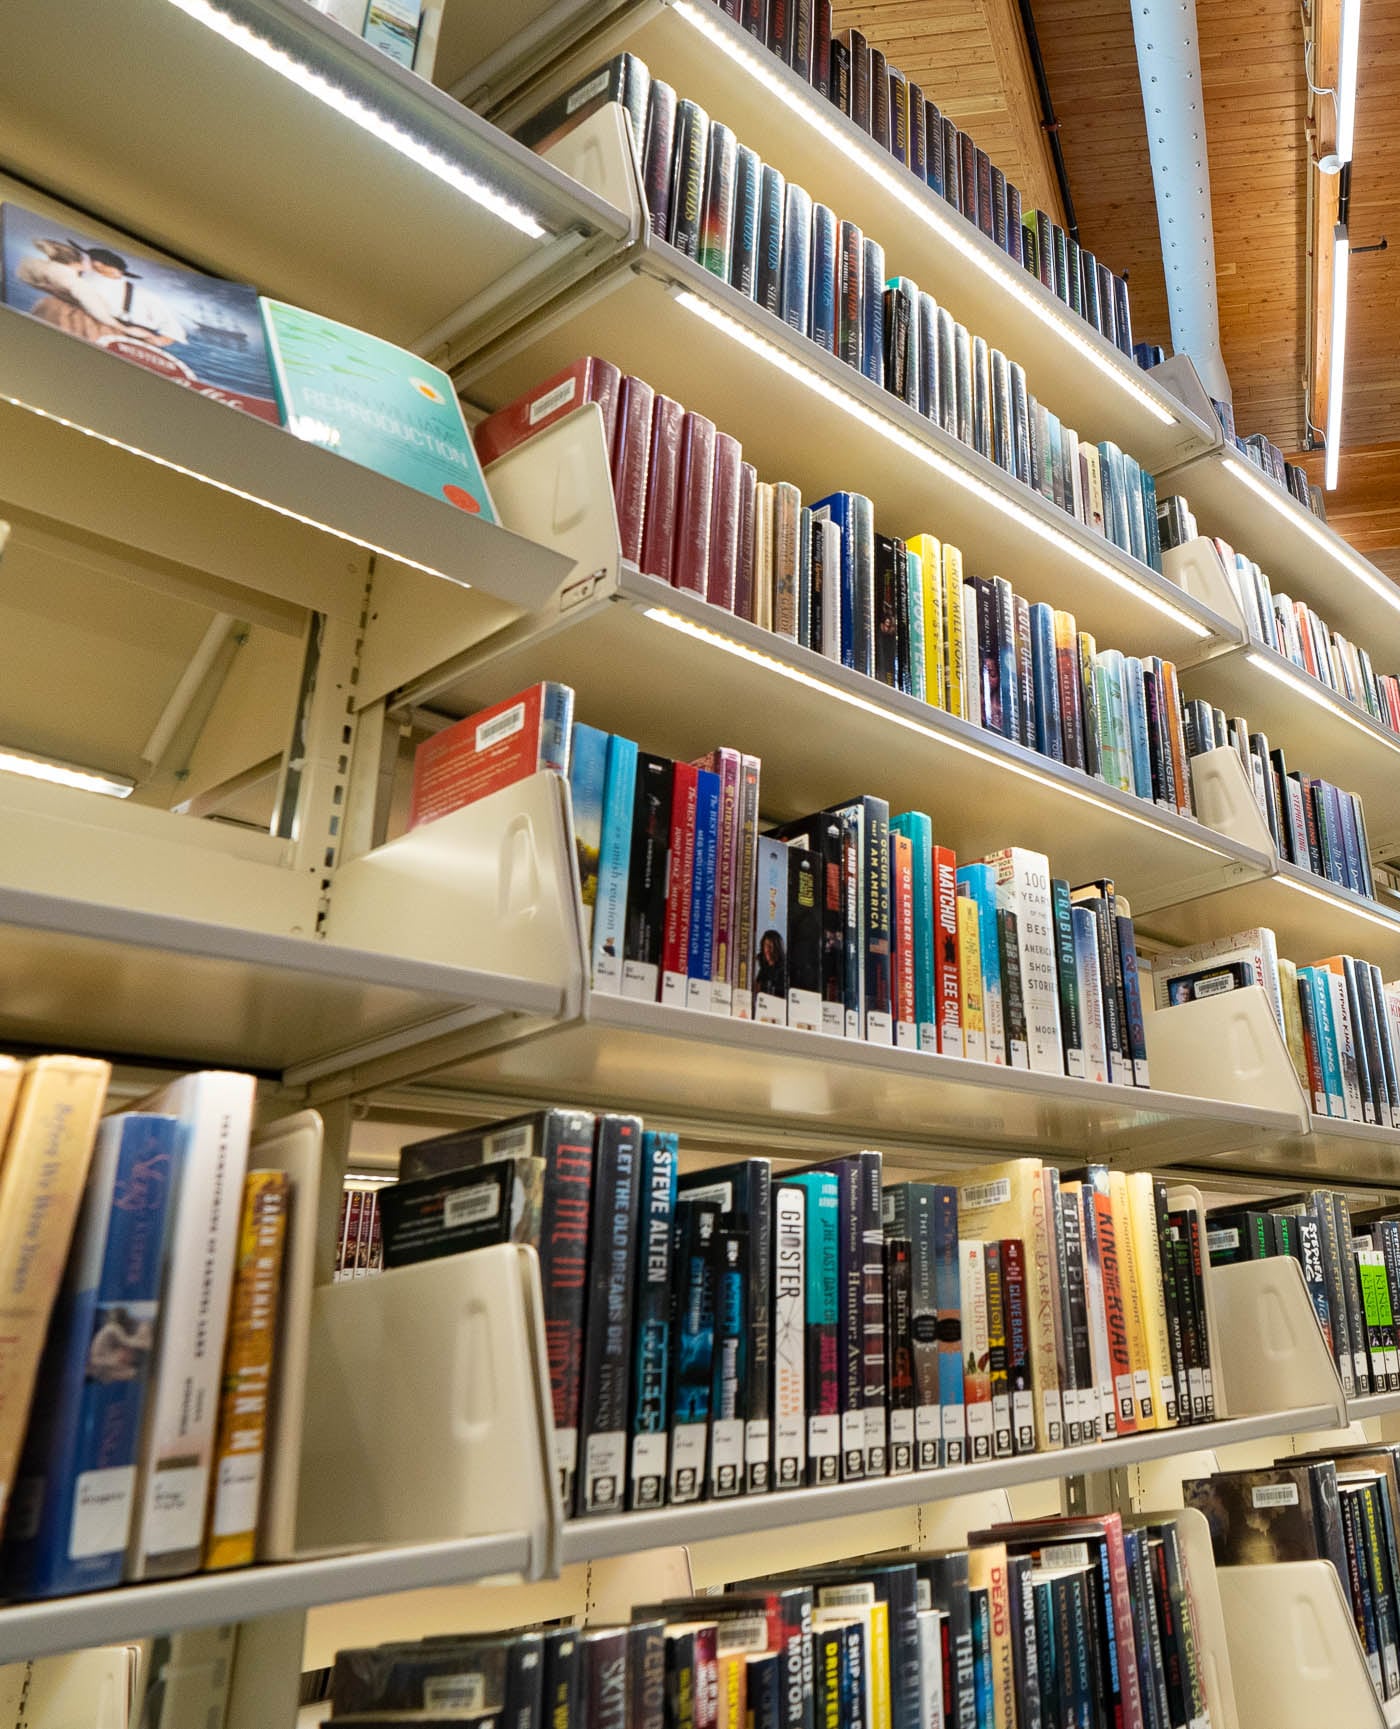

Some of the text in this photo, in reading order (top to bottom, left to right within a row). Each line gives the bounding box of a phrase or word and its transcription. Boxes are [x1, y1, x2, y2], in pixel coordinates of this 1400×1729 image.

[685, 112, 701, 221] STUART WOODS
[743, 203, 755, 251] WOODS
[767, 225, 779, 271] WOODS
[823, 262, 835, 306] WOODS
[848, 232, 858, 320] STUART WOODS
[119, 342, 178, 371] WESTERN
[848, 330, 858, 356] SKIN
[300, 385, 469, 467] REPRODUCTION
[953, 602, 961, 633] MILL
[954, 640, 963, 680] ROAD
[1018, 607, 1033, 704] LOLA ON FIRE
[1063, 675, 1074, 739] HESTER YOUNG
[1163, 742, 1176, 803] VENGEAN
[722, 798, 735, 858] CHRISTMAS
[1293, 794, 1307, 852] STEPHEN KING
[1302, 776, 1316, 846] STEPHEN KING
[606, 842, 624, 930] amish reunion
[678, 787, 696, 973] The BEST AMERICAN SHORT STORIES
[702, 795, 718, 976] The BEST AMERICAN SHORT STORIES
[739, 834, 753, 956] CHRISTMAS HEART
[847, 876, 857, 928] SENTENCES
[869, 848, 880, 929] AM AMERICA
[880, 823, 889, 930] IT OCCURS TO ME
[903, 867, 911, 890] JOE
[938, 864, 956, 934] MATCHUP
[1024, 871, 1047, 890] 100
[669, 886, 679, 943] HEIDI PITLOR
[691, 899, 701, 954] HEIDI PITLOR
[720, 894, 731, 931] HEART
[1057, 887, 1074, 964] PROBING
[942, 974, 958, 997] LEE
[1114, 953, 1122, 987] OUTTA
[1108, 999, 1119, 1049] SHADOWED
[1316, 977, 1337, 1073] STEPHEN KING
[1337, 982, 1351, 1053] STEPHEN KING
[555, 1145, 592, 1188] LET
[848, 1168, 860, 1212] Nicholas
[551, 1200, 590, 1243] ME
[606, 1144, 633, 1354] LET THE OLD DREAMS DIE
[648, 1151, 672, 1282] STEVE ALTEN
[1088, 1197, 1097, 1240] SNOWBALL
[1097, 1212, 1119, 1269] KING
[1191, 1223, 1201, 1276] PSYCHO
[1323, 1198, 1338, 1259] STEPHEN
[1340, 1200, 1360, 1301] STEPHEN KING
[250, 1193, 281, 1330] SARAH WINMAN
[550, 1257, 586, 1287] IN
[778, 1210, 801, 1299] GHOSTER
[823, 1223, 836, 1322] THE LAST DAYS OF
[919, 1213, 929, 1299] THE DAMNED
[1031, 1187, 1054, 1337] CLIVE BARKER
[1063, 1205, 1083, 1303] THE PIT
[1300, 1226, 1315, 1282] KING
[1308, 1222, 1323, 1282] STEPHEN
[1385, 1228, 1399, 1310] STEPHEN KING
[862, 1230, 884, 1397] WOUNDS
[895, 1290, 908, 1335] BITTEN
[974, 1299, 986, 1351] HUNTED
[988, 1273, 1001, 1335] MINION
[1008, 1285, 1025, 1366] CLIVE BARKER
[1107, 1295, 1129, 1367] ROAD
[1375, 1275, 1387, 1317] KING
[846, 1271, 861, 1410] Hunter: Awake
[1172, 1318, 1183, 1347] DAVID
[235, 1365, 268, 1413] TIN
[1342, 1499, 1360, 1592] STEPHEN KING
[1352, 1497, 1368, 1578] STEPHEN KING
[1363, 1489, 1384, 1593] STEPHEN KING
[990, 1567, 1005, 1637] DEAD
[1020, 1570, 1038, 1676] SIMON CLARK
[1059, 1586, 1071, 1649] DOUGLAS
[1072, 1582, 1088, 1691] DOUGLAS CLEGG
[1099, 1544, 1121, 1693] BLAKE JORDAN CROUCH
[1114, 1568, 1134, 1656] DEEP
[1141, 1540, 1162, 1668] THE TWENTY DAYS OF TURIN
[643, 1636, 663, 1706] ZERO
[787, 1634, 804, 1721] MOTOR
[801, 1602, 813, 1700] SUICIDE
[955, 1629, 974, 1683] THE
[1179, 1599, 1203, 1718] THE CHRYSA
[1001, 1644, 1016, 1729] TYPHOON
[1127, 1663, 1139, 1710] NICK
